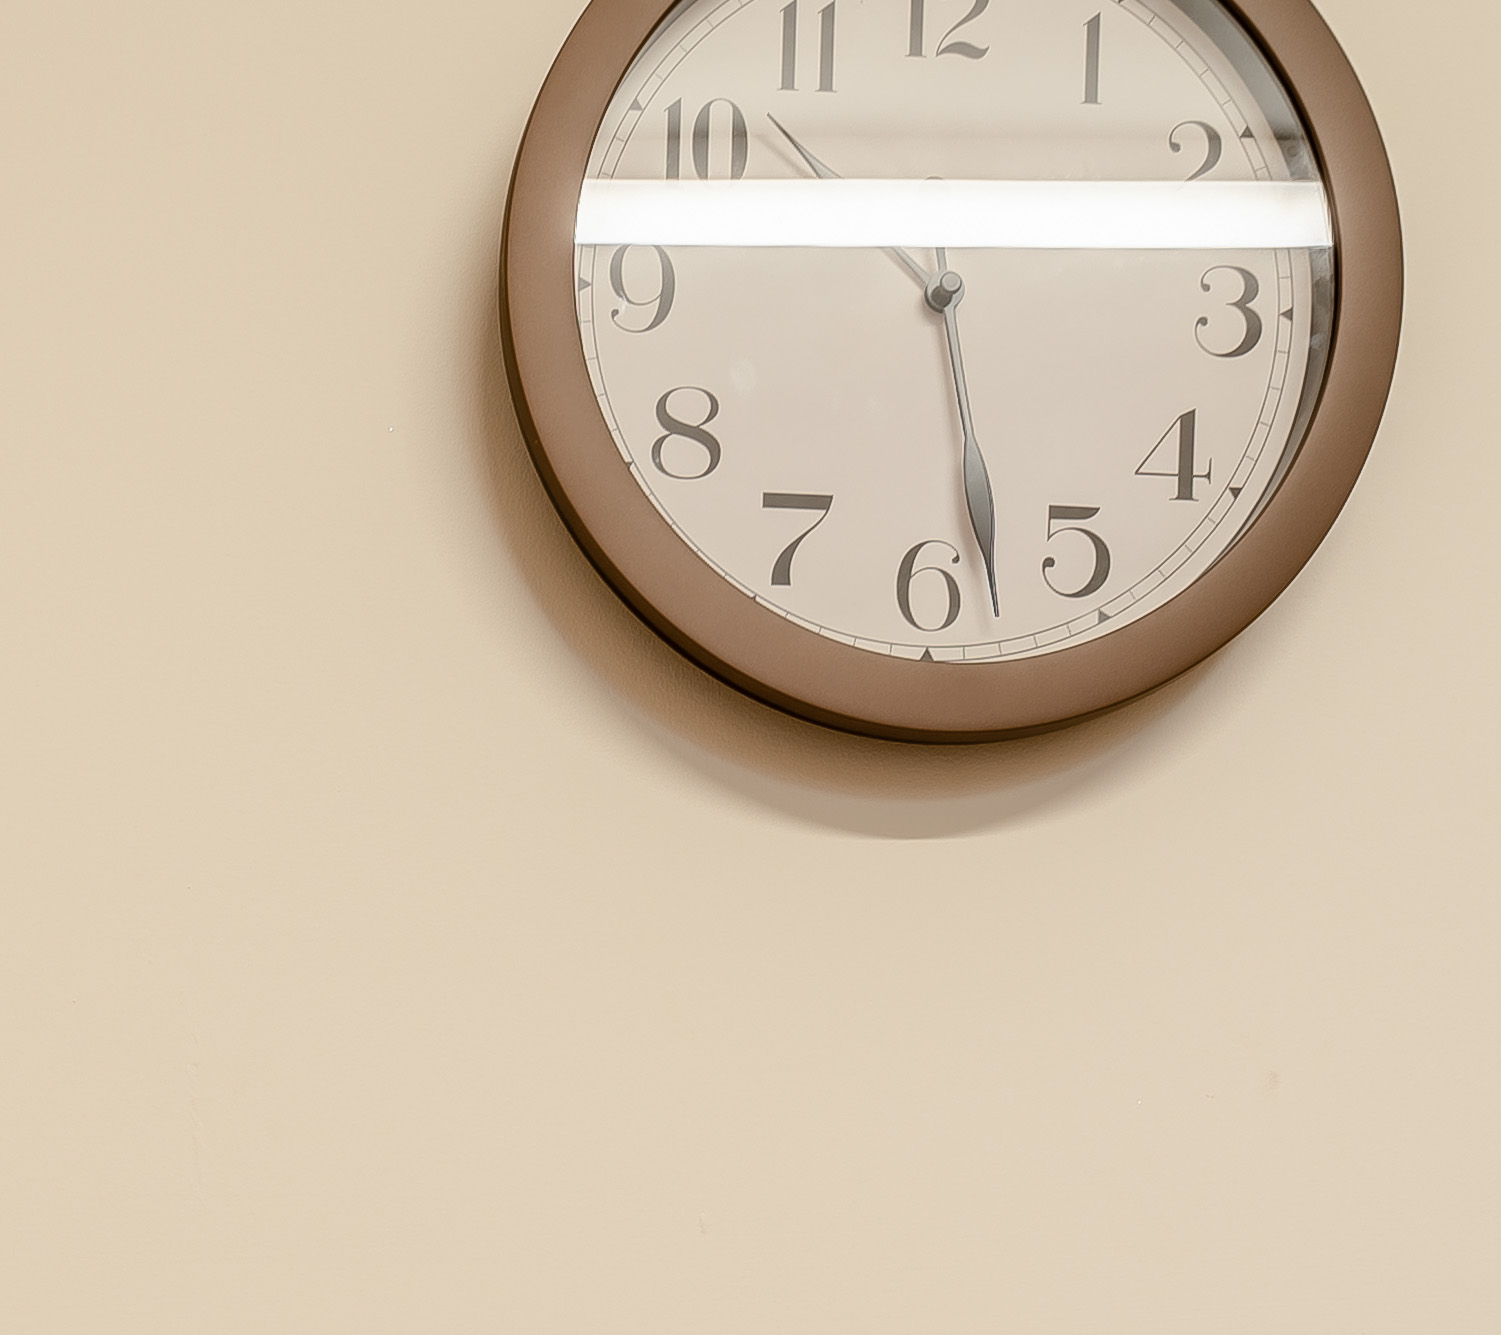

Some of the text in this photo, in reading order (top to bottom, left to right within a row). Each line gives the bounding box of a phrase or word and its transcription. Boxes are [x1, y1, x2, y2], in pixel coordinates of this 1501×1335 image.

[777, 0, 838, 92] 11
[905, 0, 990, 60] 12
[1080, 11, 1102, 105] 1
[664, 98, 749, 182] 10
[1168, 120, 1222, 183] 2
[609, 244, 676, 333] 9
[1195, 265, 1262, 358] 3
[651, 386, 722, 480] 8
[1134, 408, 1211, 502] 4
[762, 492, 834, 586] 7
[1041, 505, 1111, 599] 5
[896, 540, 961, 633] 6
